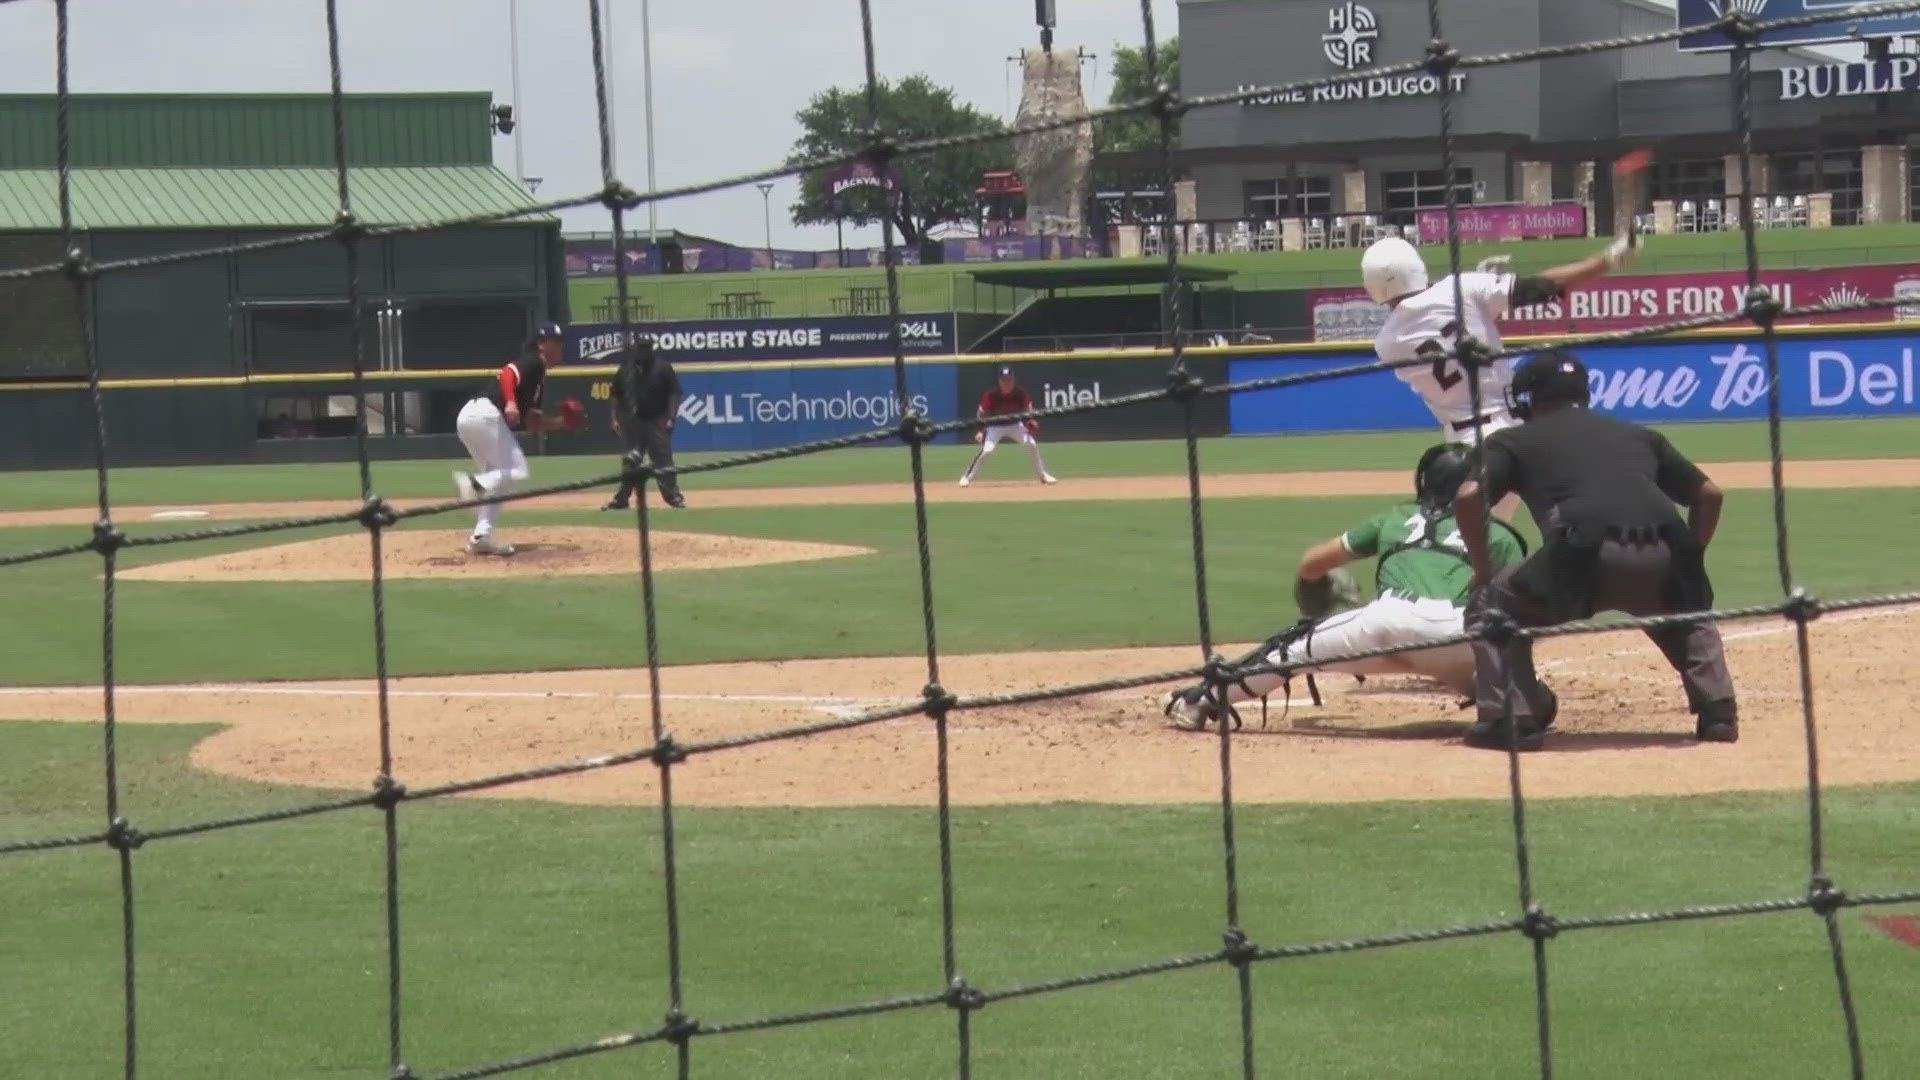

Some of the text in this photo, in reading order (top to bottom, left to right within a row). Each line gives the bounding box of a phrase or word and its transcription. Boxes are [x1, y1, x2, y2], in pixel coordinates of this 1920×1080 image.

[1778, 57, 1920, 100] BULLP
[1524, 212, 1575, 229] Mobile
[1569, 288, 1659, 319] BUD'S
[1666, 286, 1724, 315] FOR
[751, 328, 822, 348] STAGE
[829, 332, 889, 342] PRESENTED BY
[1710, 344, 1770, 411] to
[590, 381, 613, 401] 40
[1044, 381, 1100, 409] intel
